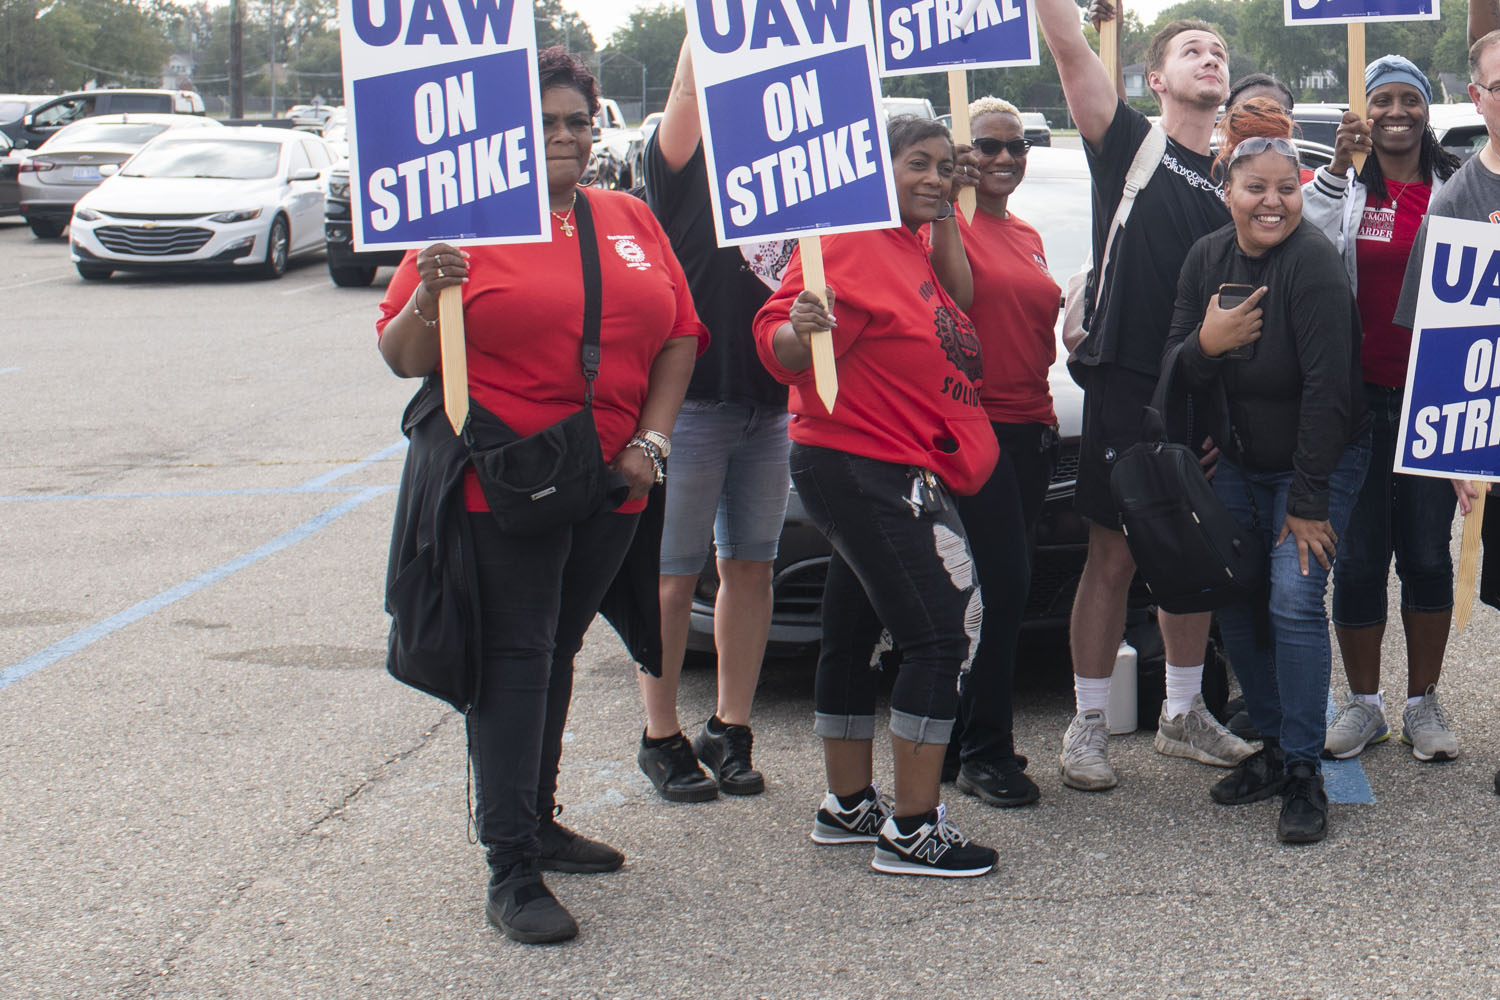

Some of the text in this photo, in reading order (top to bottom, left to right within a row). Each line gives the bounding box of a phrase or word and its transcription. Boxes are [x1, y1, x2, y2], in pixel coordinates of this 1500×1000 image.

[413, 71, 477, 145] ON
[762, 69, 824, 142] ON
[368, 125, 531, 232] STRIKE
[725, 118, 879, 228] STRIKE
[1360, 227, 1393, 239] ARDER
[1363, 211, 1395, 222] CKAGING
